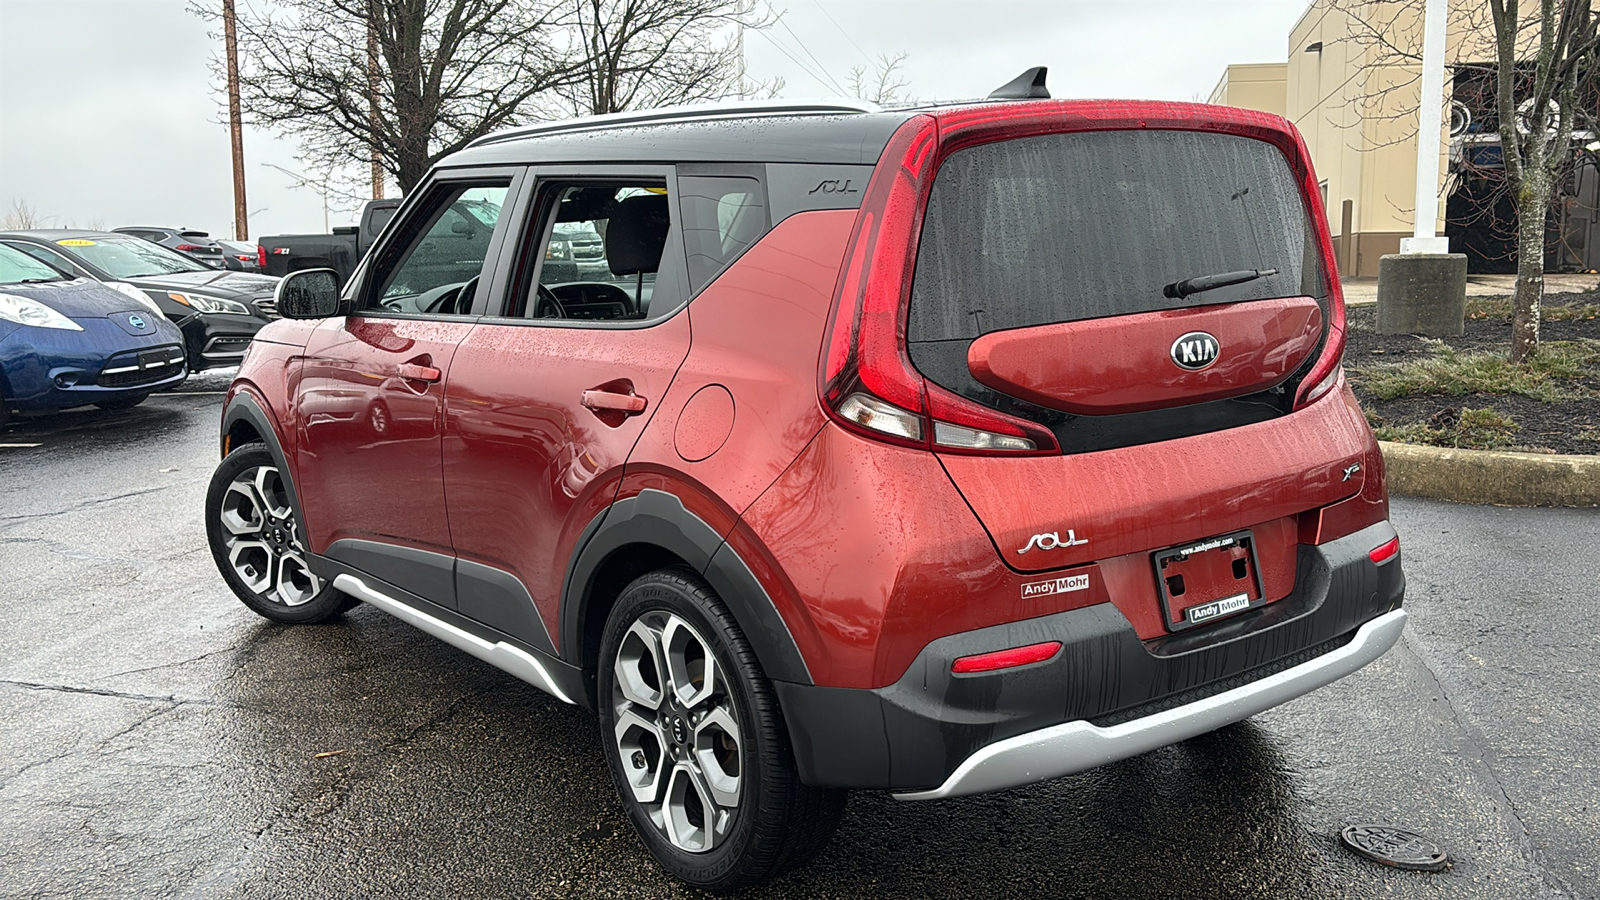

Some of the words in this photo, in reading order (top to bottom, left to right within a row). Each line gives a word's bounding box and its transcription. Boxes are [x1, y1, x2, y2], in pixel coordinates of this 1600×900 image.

[808, 179, 858, 195] SOUL
[1180, 339, 1215, 363] KIA
[1016, 529, 1089, 554] SOUL
[1180, 537, 1234, 555] www.andymohr.com
[1024, 582, 1055, 595] Andy
[1058, 577, 1088, 590] Mohr
[1193, 604, 1219, 619] Andy
[1221, 597, 1247, 612] Mohr
[674, 718, 683, 742] KIA
